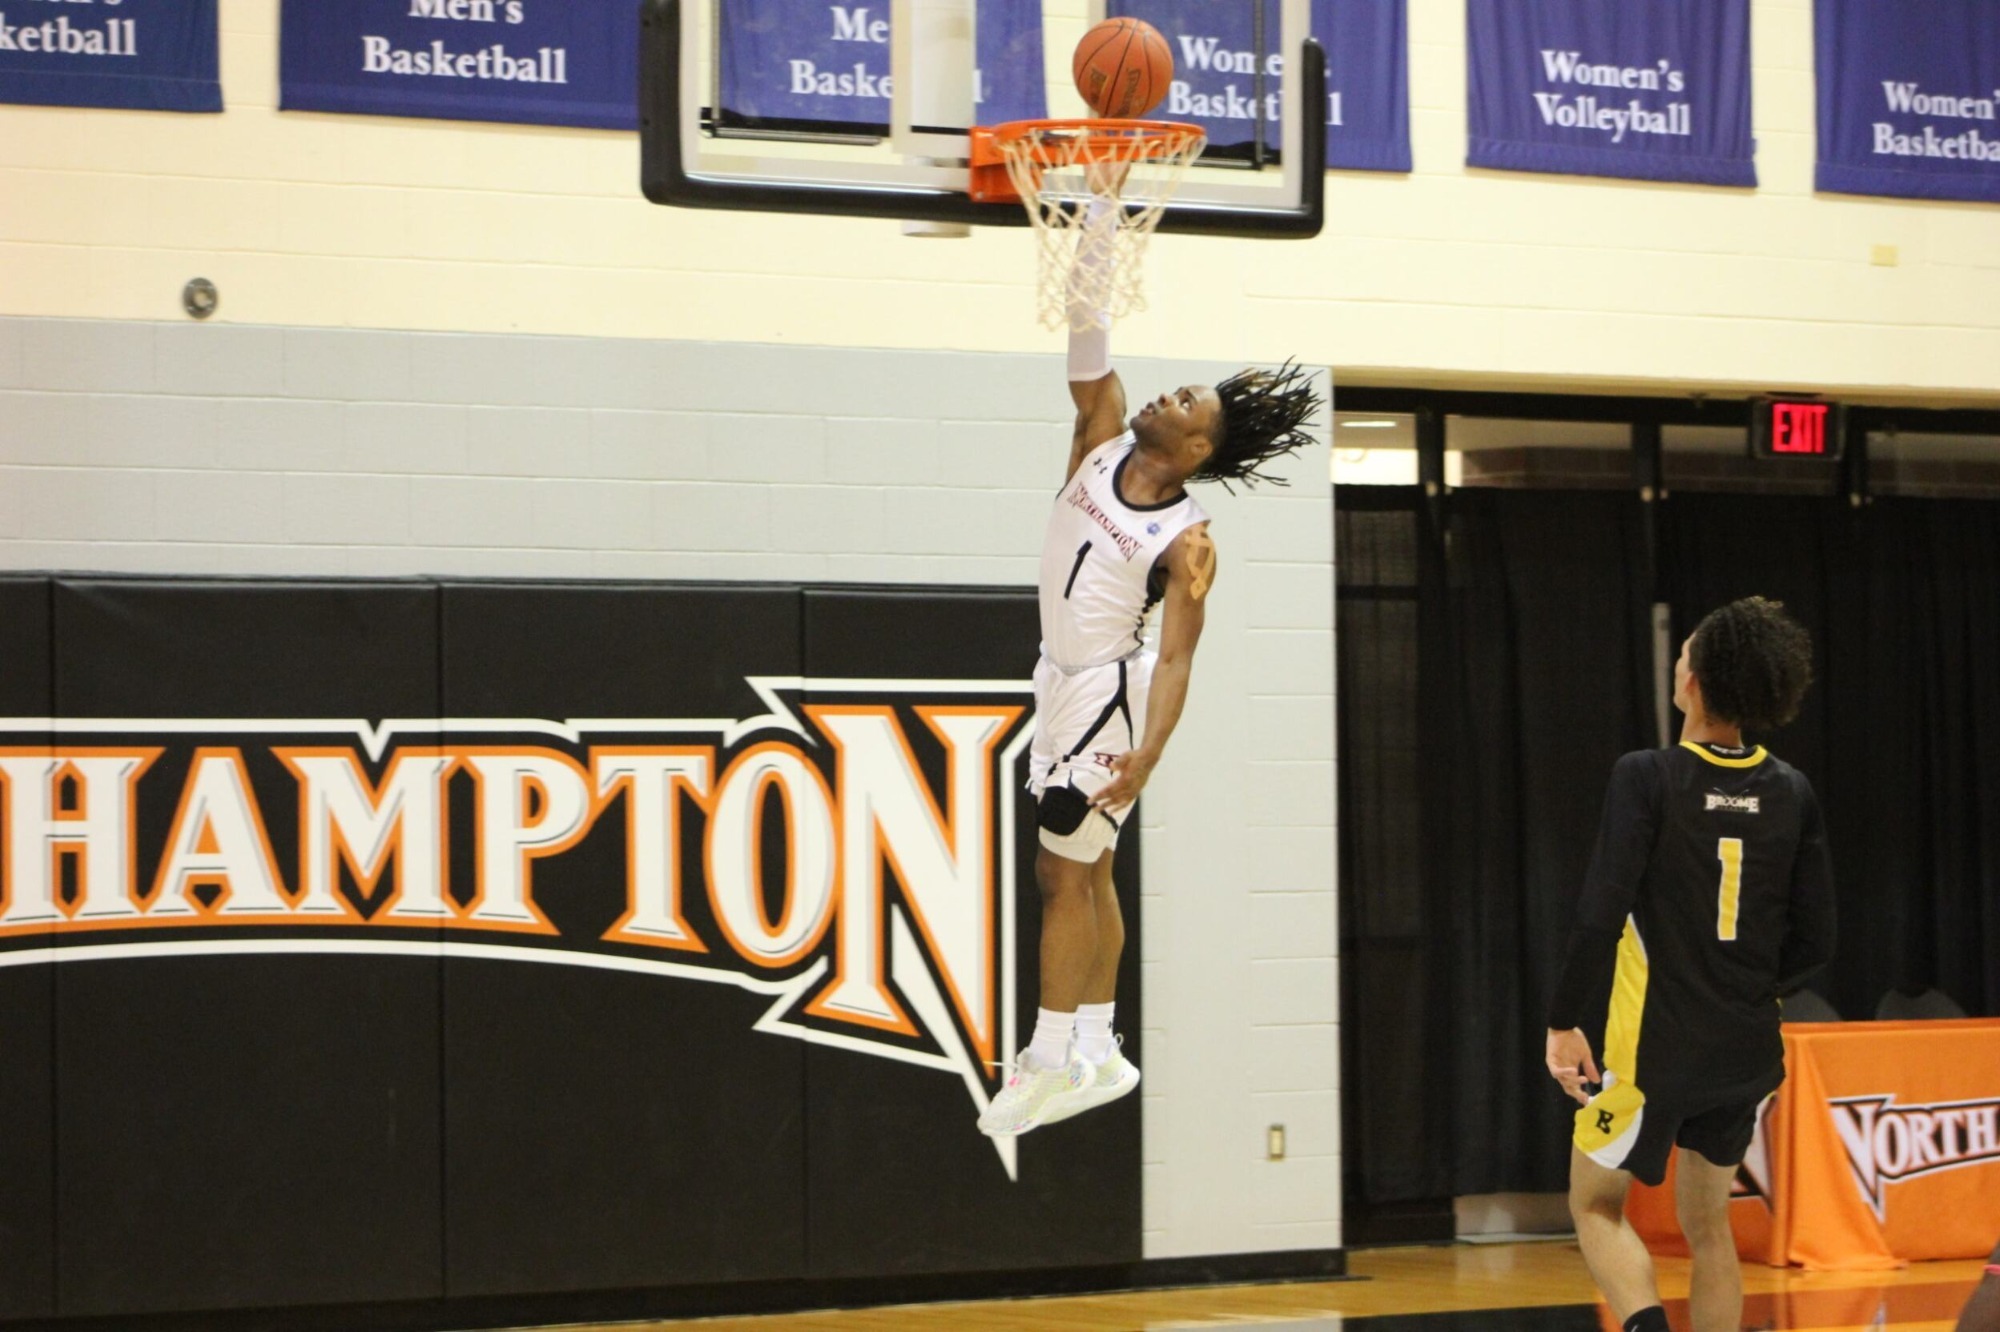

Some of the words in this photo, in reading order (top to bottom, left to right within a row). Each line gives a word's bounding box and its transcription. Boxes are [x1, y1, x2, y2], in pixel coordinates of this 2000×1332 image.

[0, 12, 137, 55] ketball
[1177, 35, 1332, 78] Wome
[361, 35, 568, 84] Basketball
[788, 59, 984, 103] Baskel
[1540, 50, 1685, 92] Women's
[1532, 92, 1691, 143] Volleyball
[1773, 403, 1828, 453] EXIT
[1064, 540, 1093, 600] 1
[0, 704, 1025, 1078] HAMPTON
[1717, 838, 1743, 941] 1
